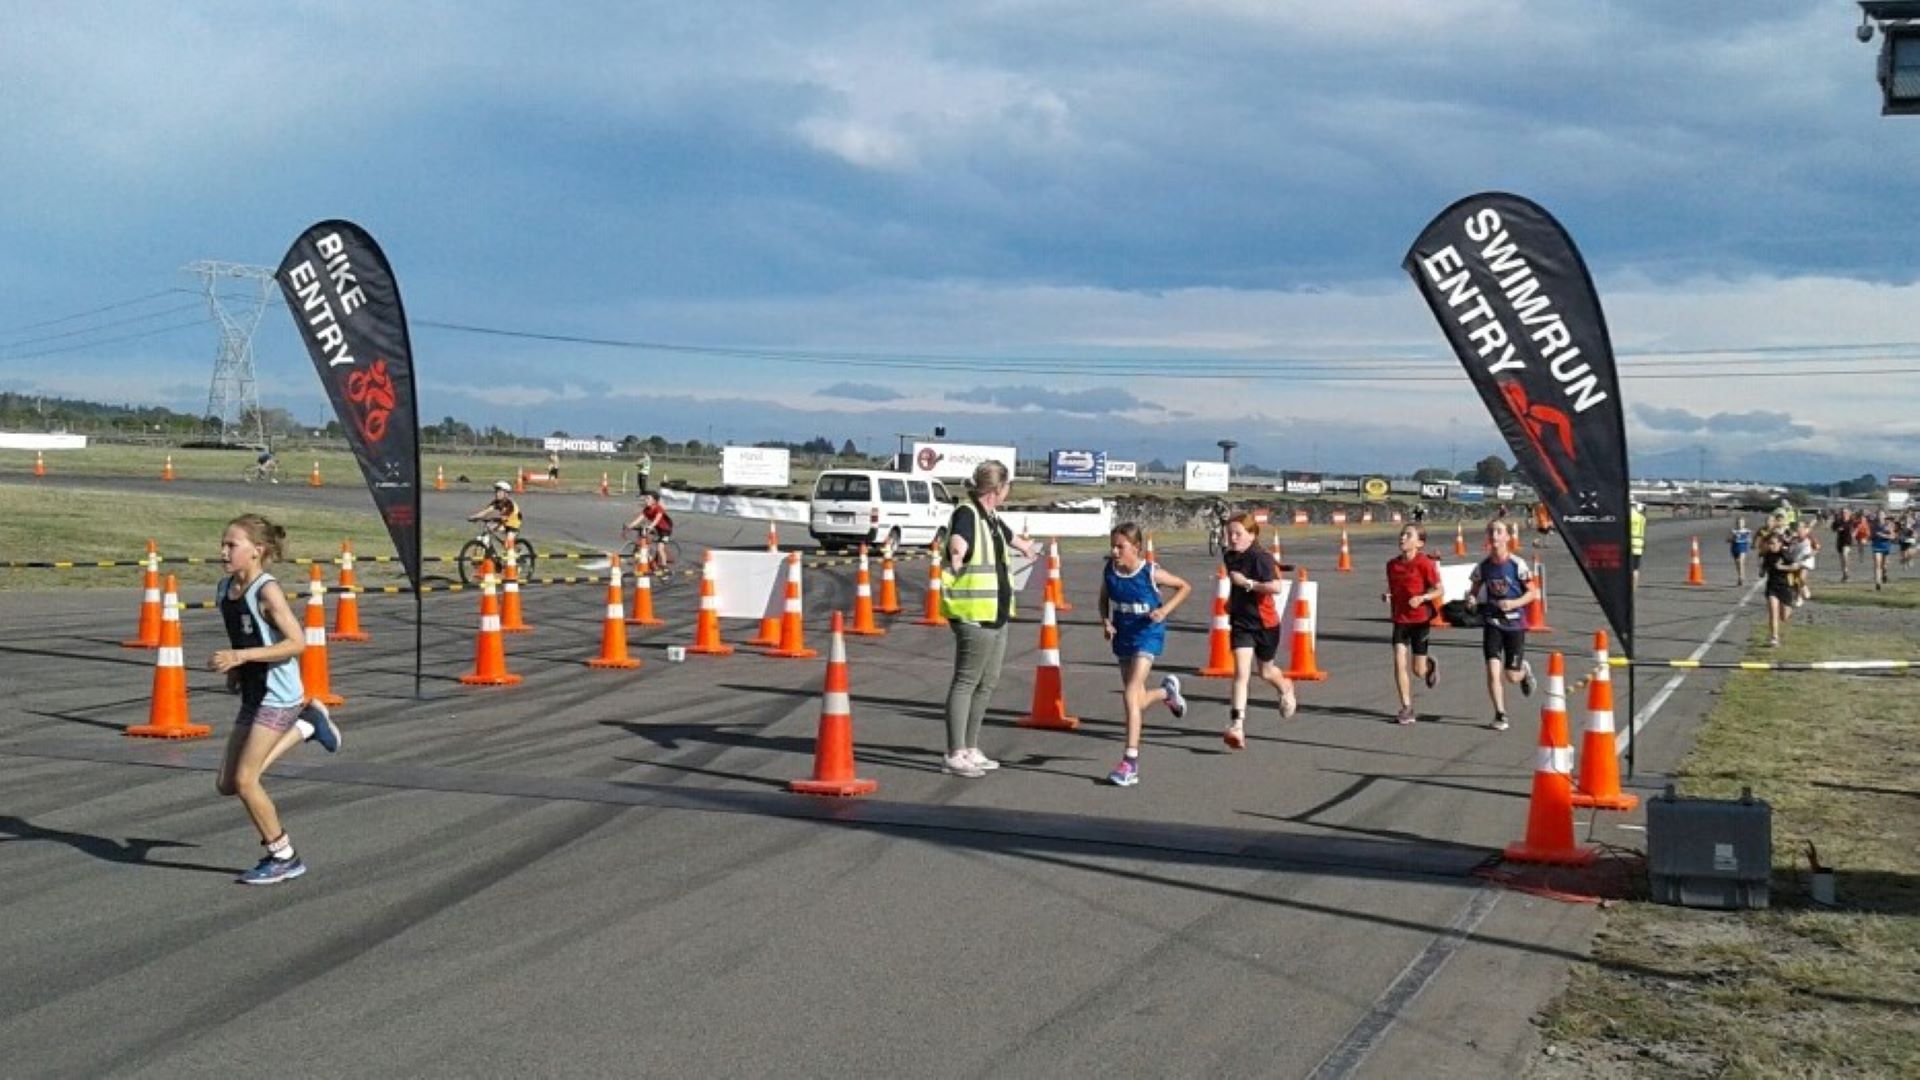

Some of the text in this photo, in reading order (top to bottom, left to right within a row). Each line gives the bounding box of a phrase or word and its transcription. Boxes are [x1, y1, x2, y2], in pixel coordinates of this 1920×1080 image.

[289, 260, 354, 367] ENTRY
[316, 232, 367, 315] BIKE
[1423, 244, 1526, 375] ENTRY
[1464, 208, 1607, 414] SWIM/RUN
[563, 439, 598, 452] MOTOR
